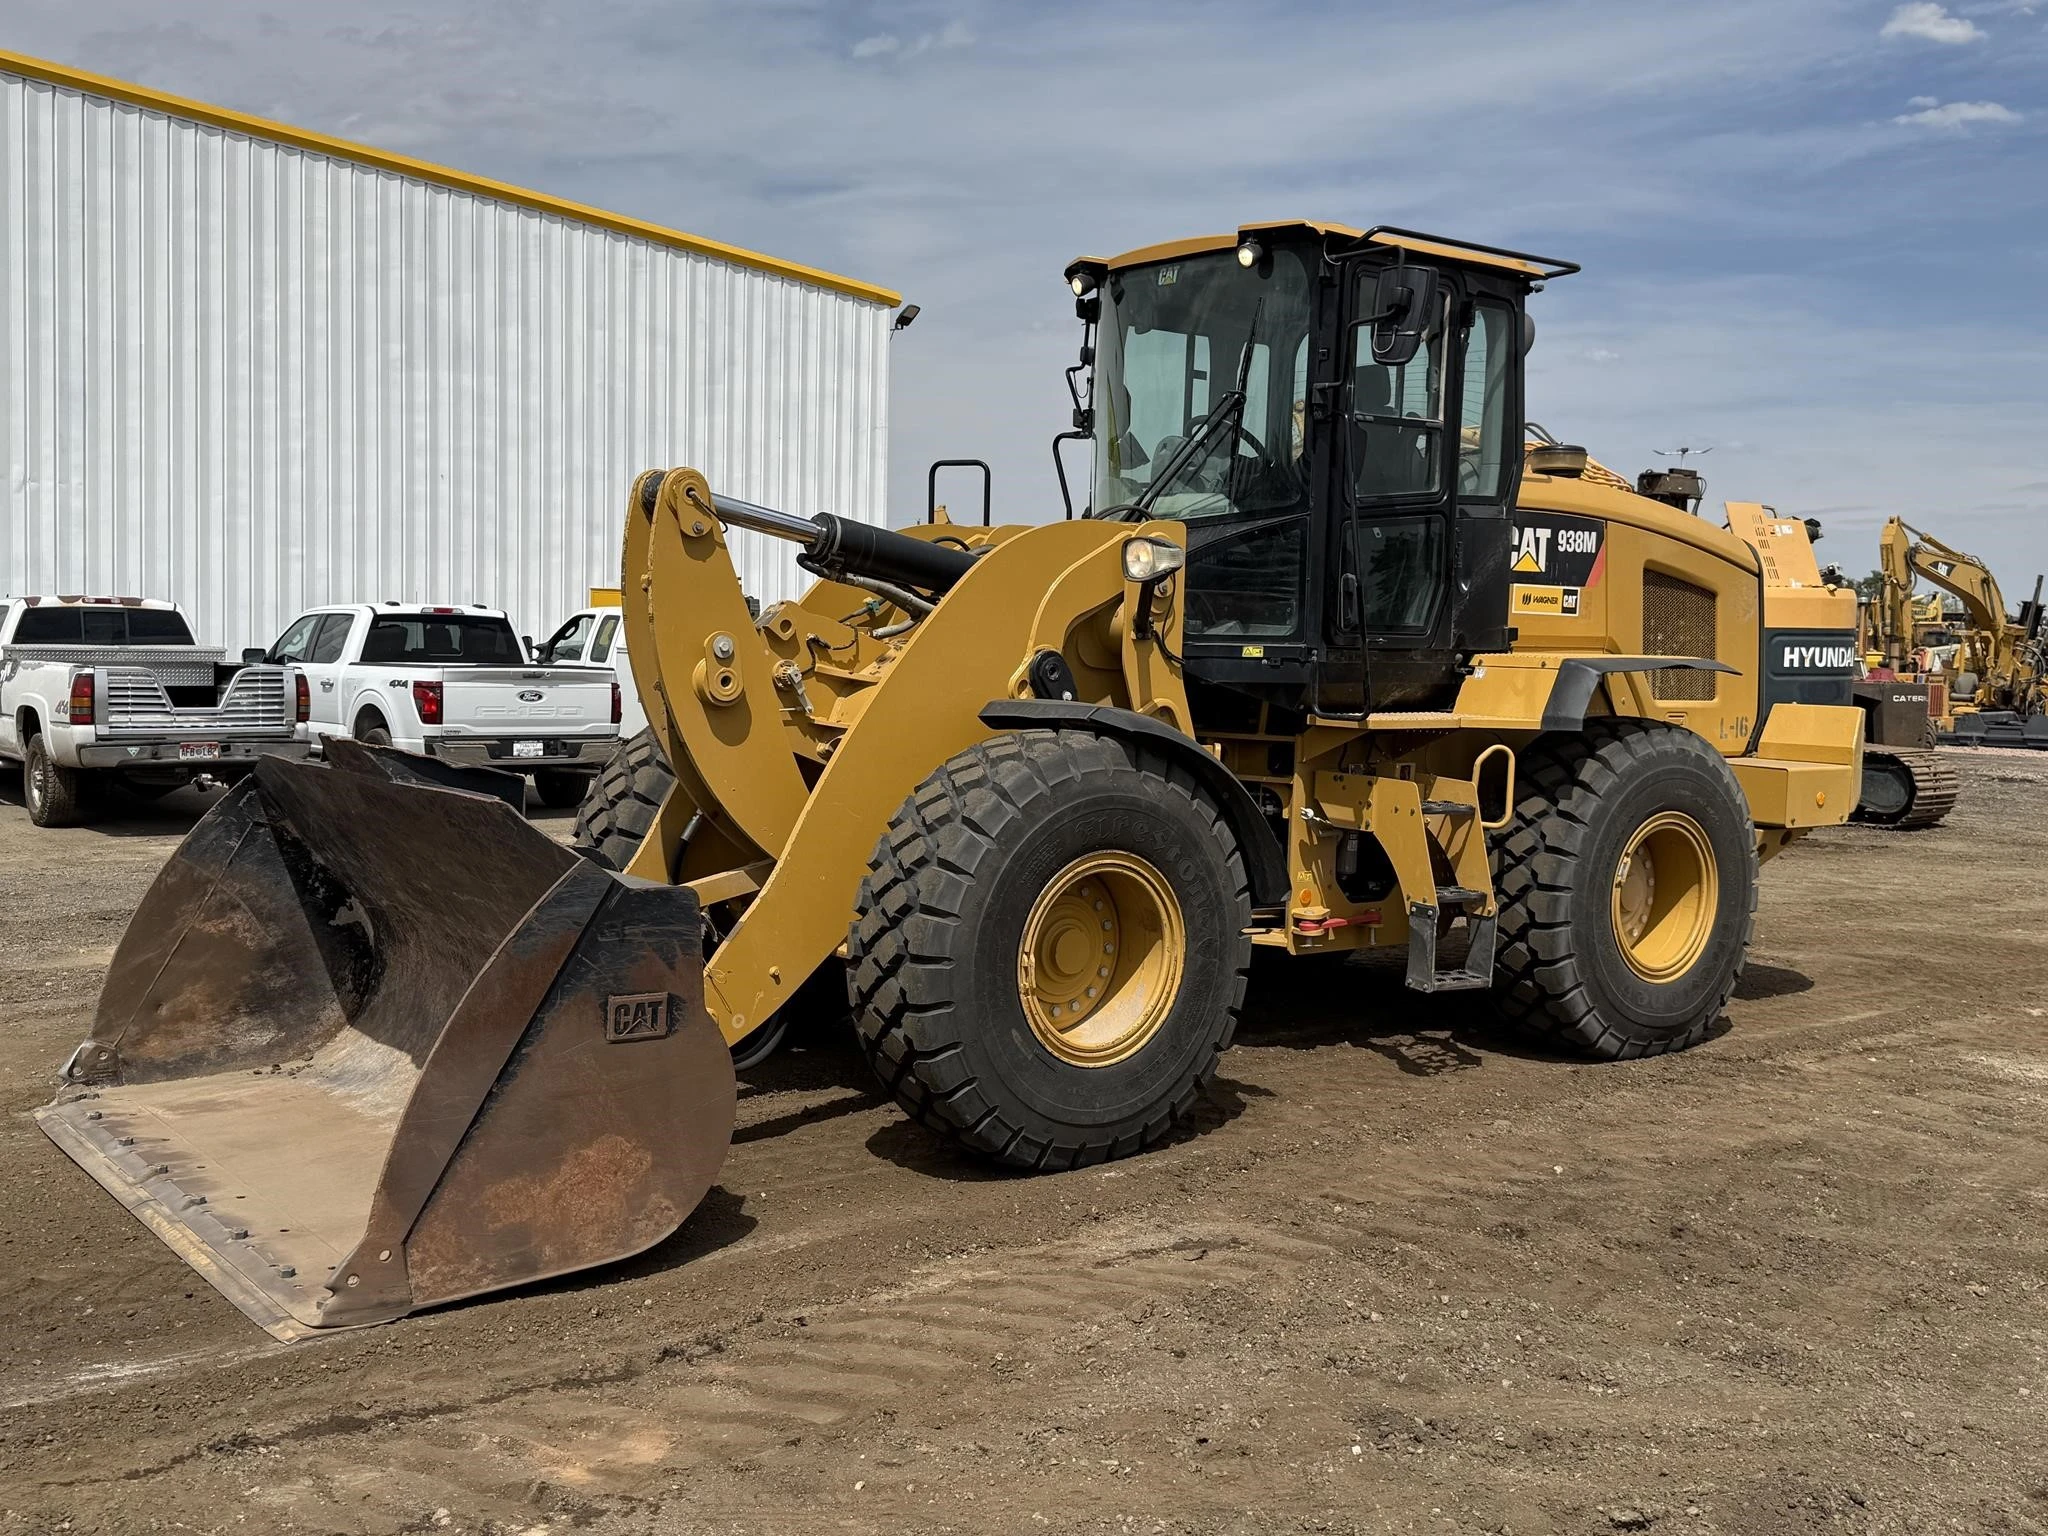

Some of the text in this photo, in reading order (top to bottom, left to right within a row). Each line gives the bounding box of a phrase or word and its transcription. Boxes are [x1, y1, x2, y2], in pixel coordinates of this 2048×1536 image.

[1158, 265, 1180, 286] CAT
[1557, 529, 1598, 554] 938M
[1532, 594, 1578, 608] WAGNER CAT
[1783, 646, 1855, 668] HYUNDAI
[521, 691, 541, 701] Ford
[474, 705, 585, 719] F-150
[614, 1000, 664, 1036] CAT
